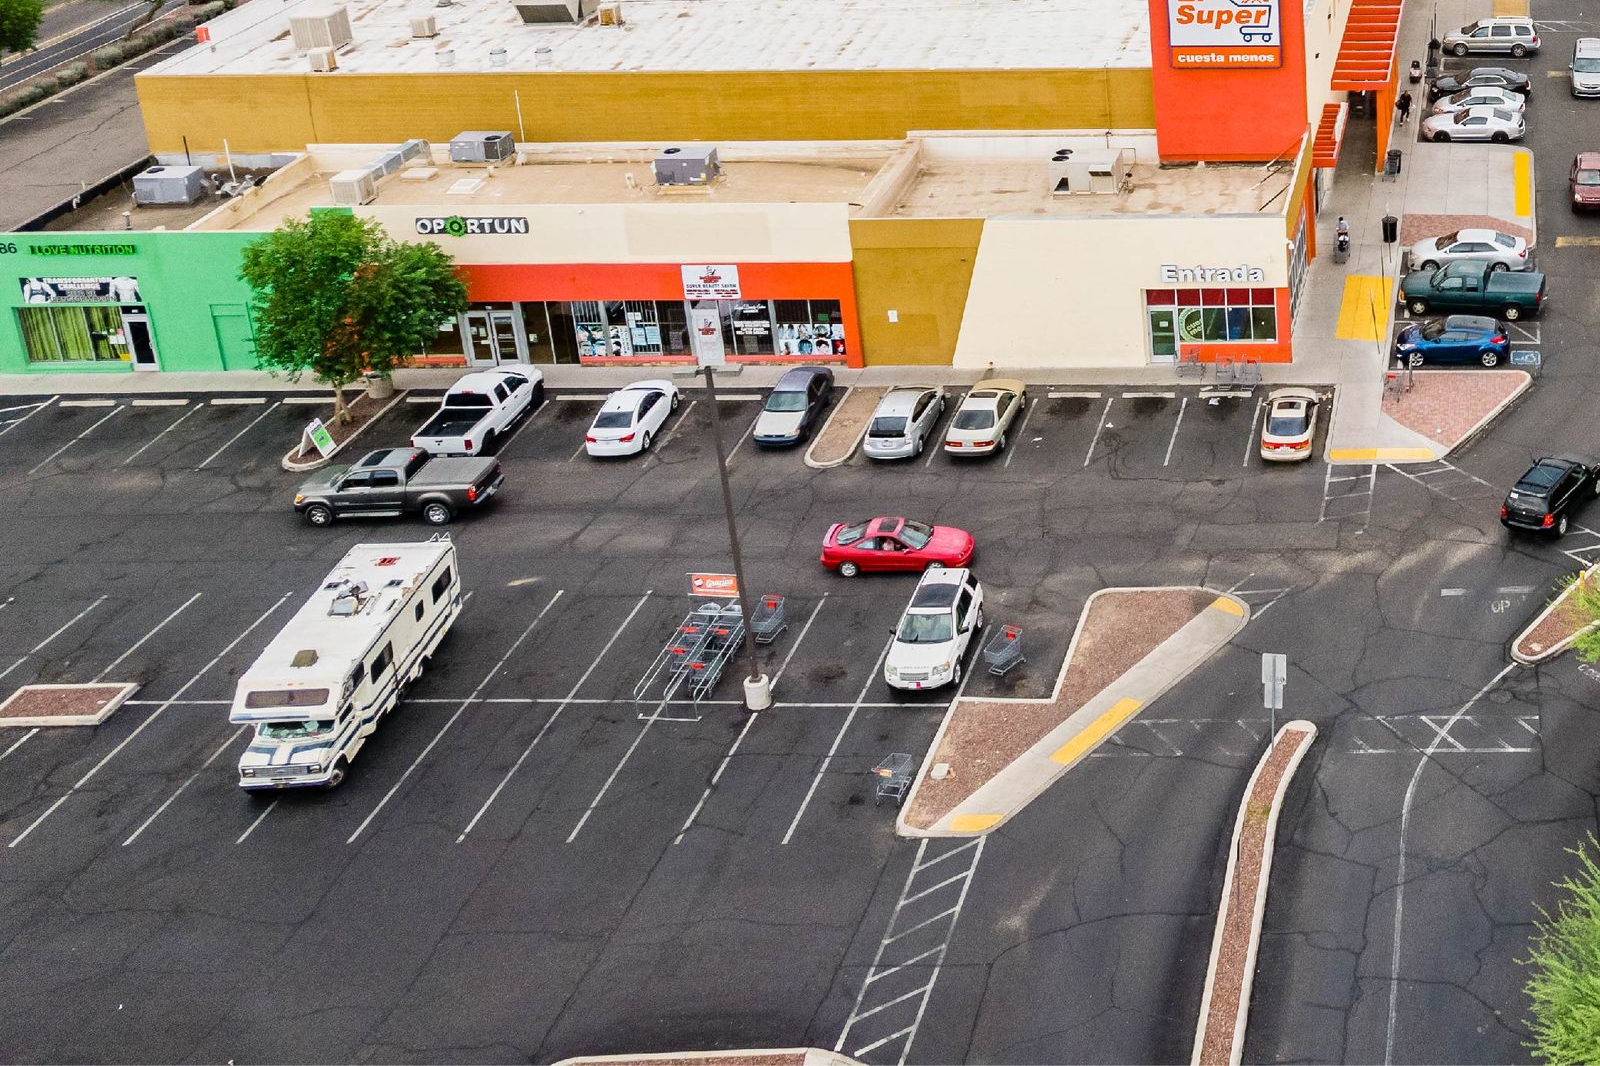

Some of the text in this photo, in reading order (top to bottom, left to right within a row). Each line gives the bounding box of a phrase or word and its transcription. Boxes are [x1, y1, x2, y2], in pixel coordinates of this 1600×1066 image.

[1176, 4, 1267, 29] Super
[1178, 53, 1275, 63] cuesta menos
[416, 216, 527, 236] OPORTUN
[35, 245, 67, 255] LOVE
[70, 244, 135, 255] NUTRITION
[1160, 264, 1264, 283] Entrada
